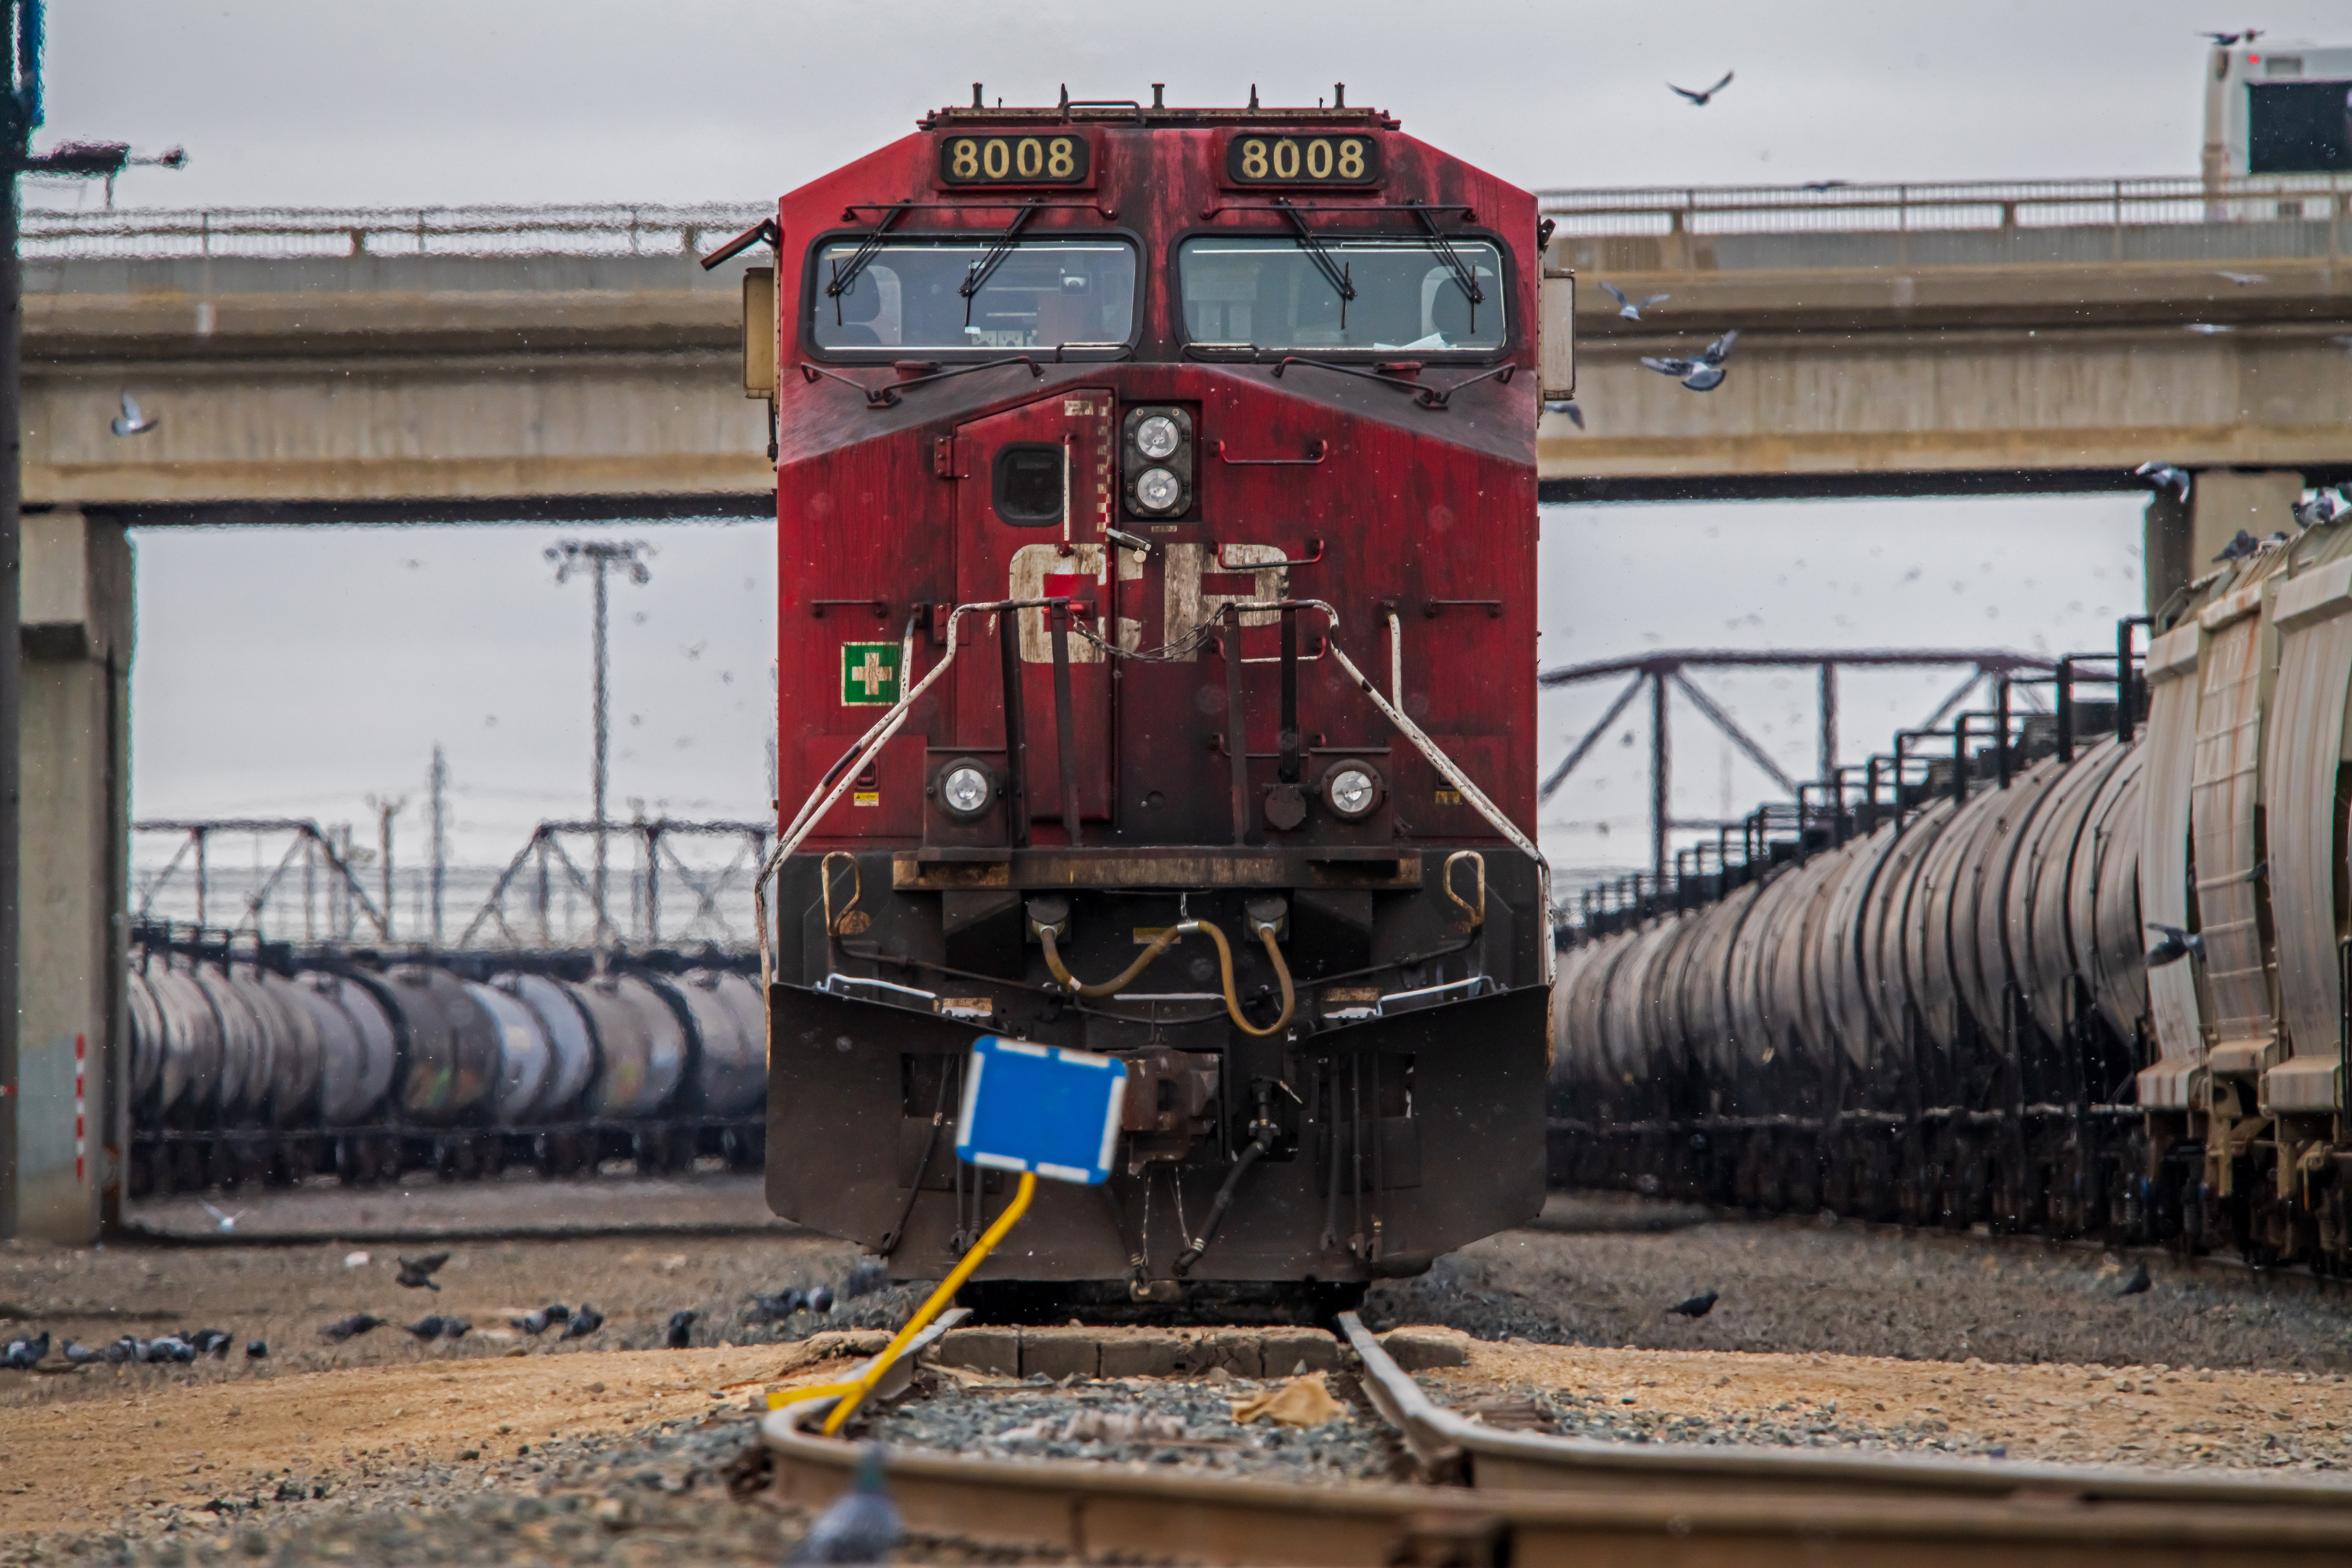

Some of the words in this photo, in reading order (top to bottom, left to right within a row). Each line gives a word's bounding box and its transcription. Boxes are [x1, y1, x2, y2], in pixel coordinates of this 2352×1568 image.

[953, 138, 1074, 179] 8008
[1242, 139, 1365, 179] 8008
[1009, 543, 1289, 663] CP
